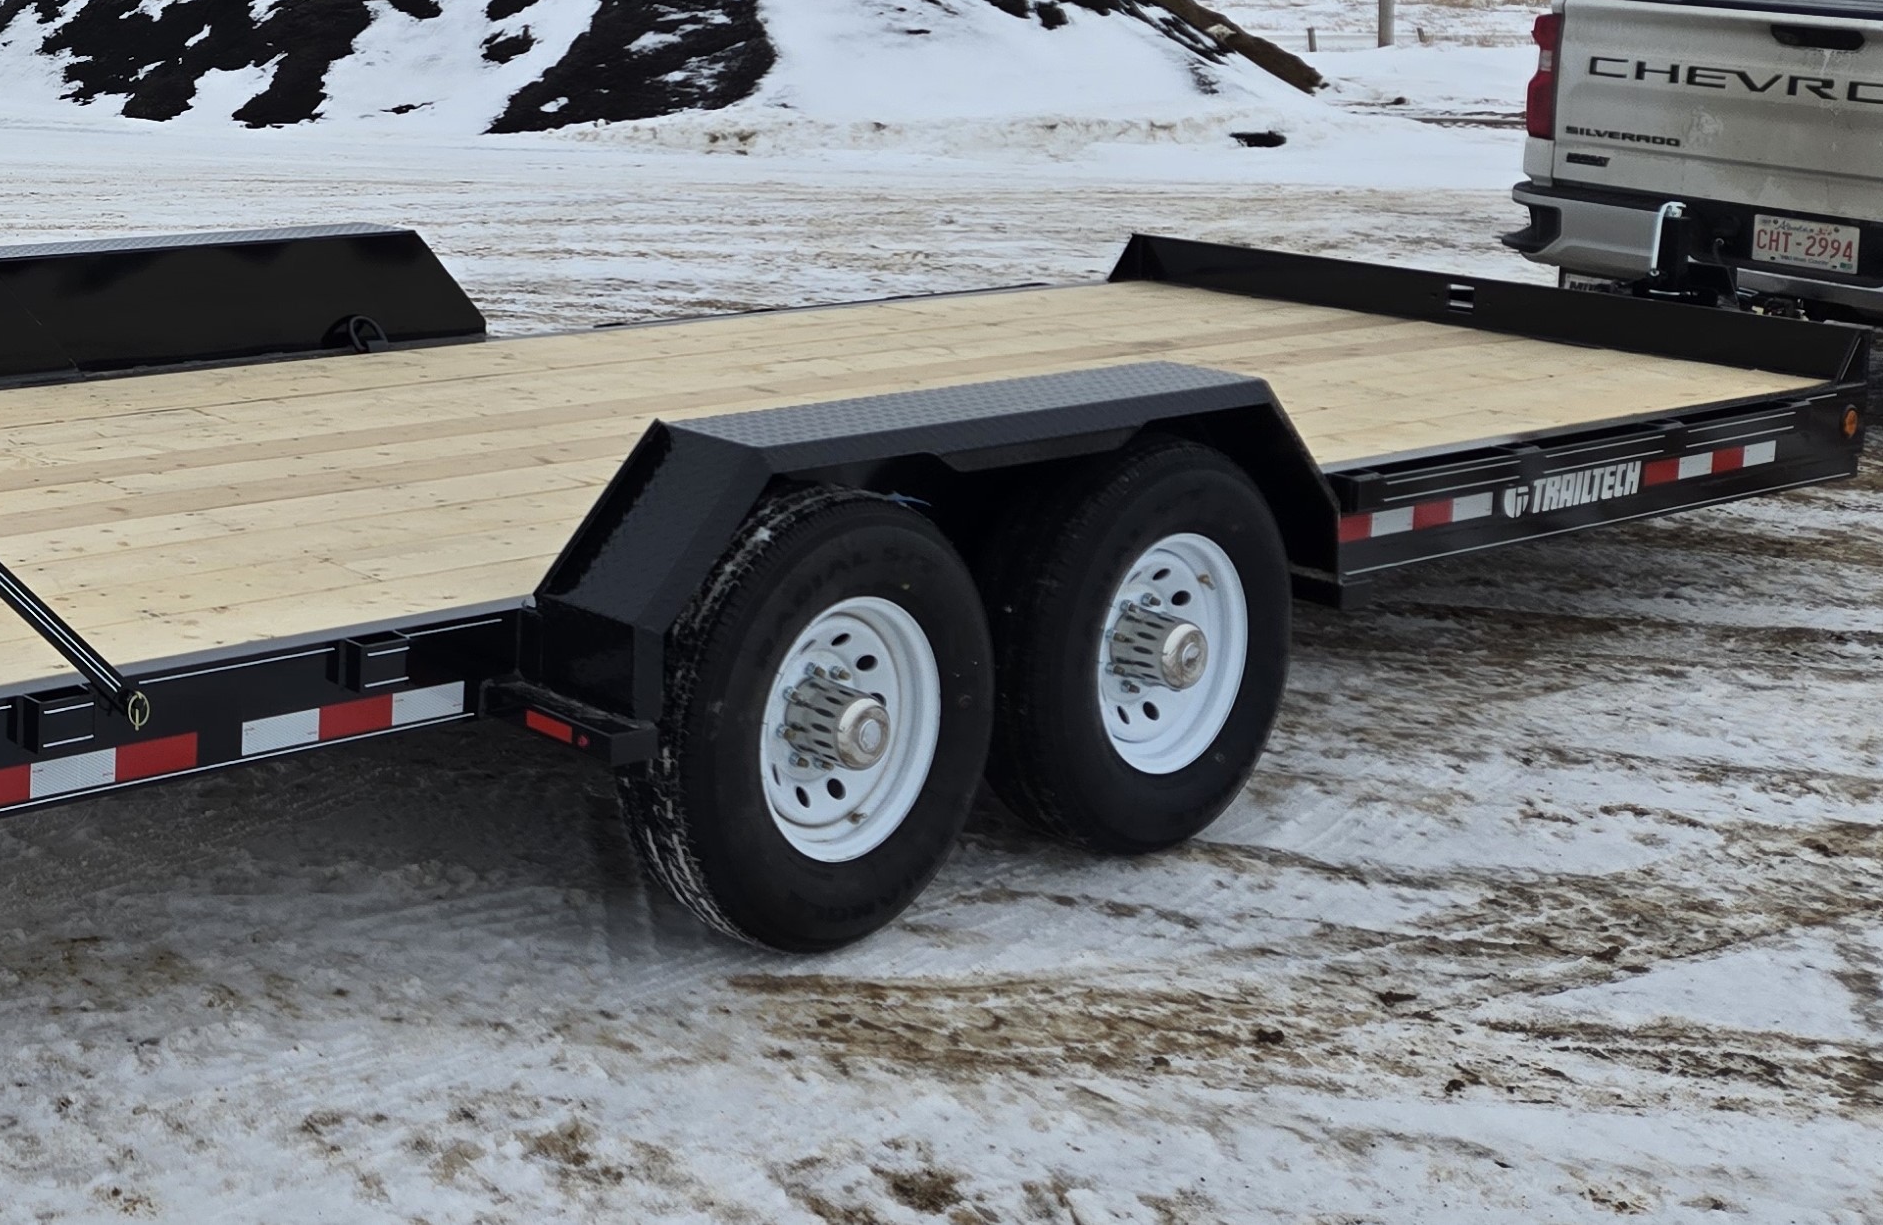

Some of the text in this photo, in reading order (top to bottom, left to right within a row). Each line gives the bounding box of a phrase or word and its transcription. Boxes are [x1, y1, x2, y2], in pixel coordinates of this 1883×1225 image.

[1565, 125, 1681, 147] SILVERADO
[1756, 229, 1854, 262] CHT-2994
[1532, 460, 1642, 514] TRAILTECH
